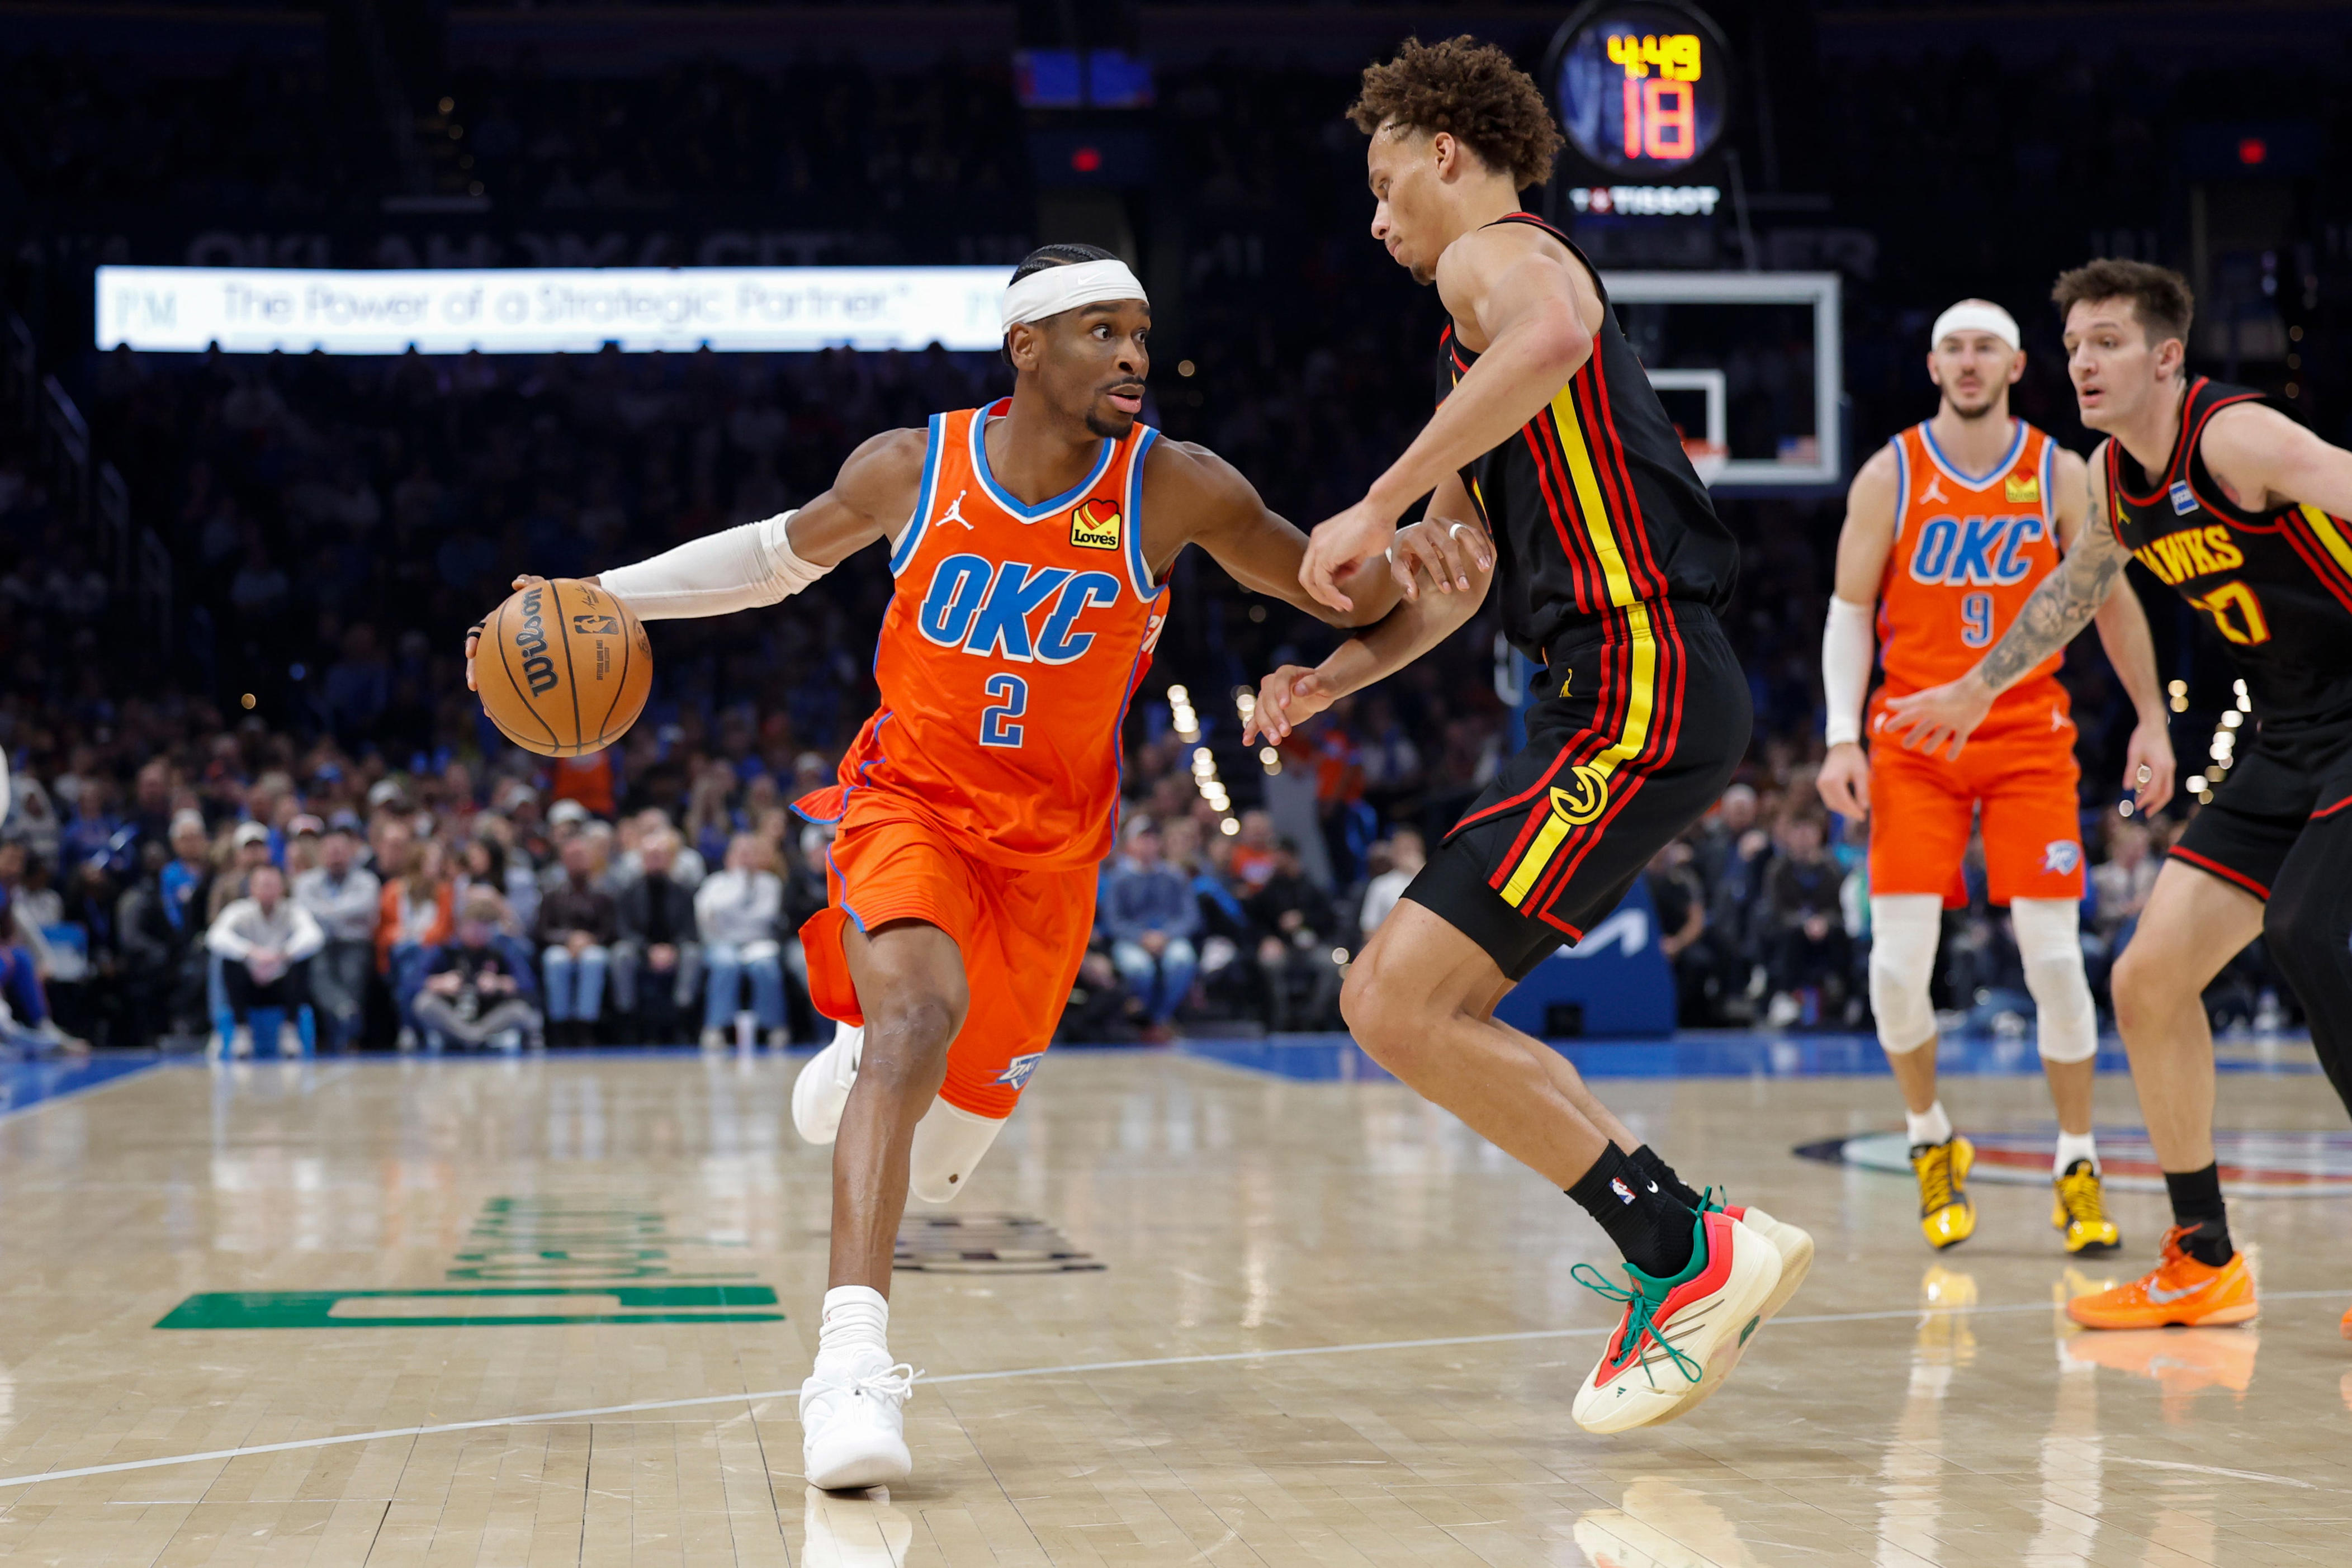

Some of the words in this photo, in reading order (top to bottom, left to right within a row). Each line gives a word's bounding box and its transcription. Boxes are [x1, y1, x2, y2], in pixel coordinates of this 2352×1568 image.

[1607, 34, 1701, 82] 4:49
[1622, 78, 1696, 159] 18
[1908, 513, 2045, 586] OKC
[2132, 523, 2245, 586] AWKS
[515, 586, 559, 699] Wilson
[917, 553, 1121, 665] OKC
[1961, 590, 1995, 649] 9
[979, 672, 1029, 749] 2
